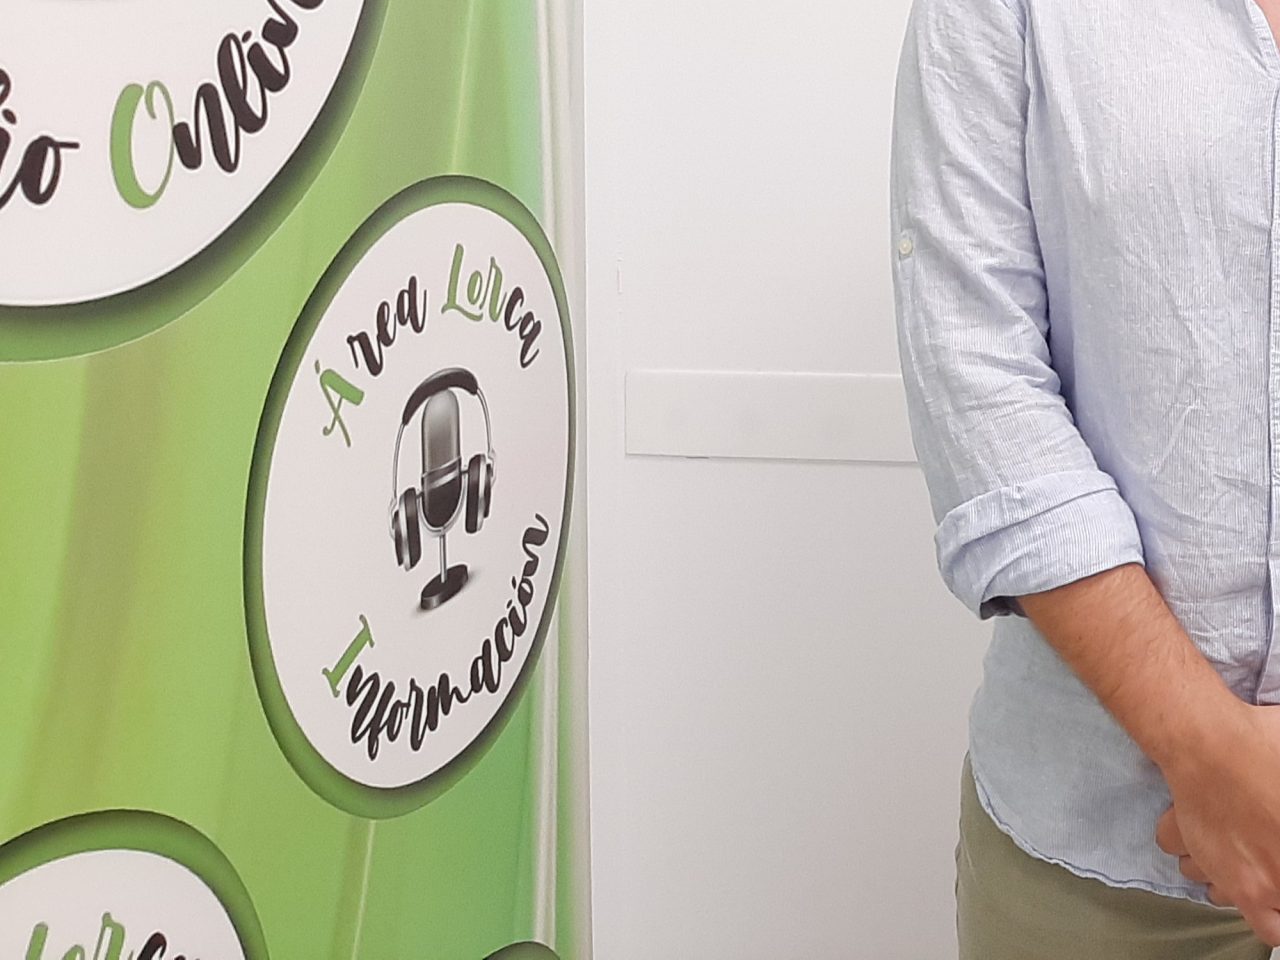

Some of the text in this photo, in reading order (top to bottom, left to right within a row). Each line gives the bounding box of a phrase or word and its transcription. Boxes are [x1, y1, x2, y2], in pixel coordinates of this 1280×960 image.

[314, 243, 542, 448] Área Lorca
[321, 513, 550, 761] Información
